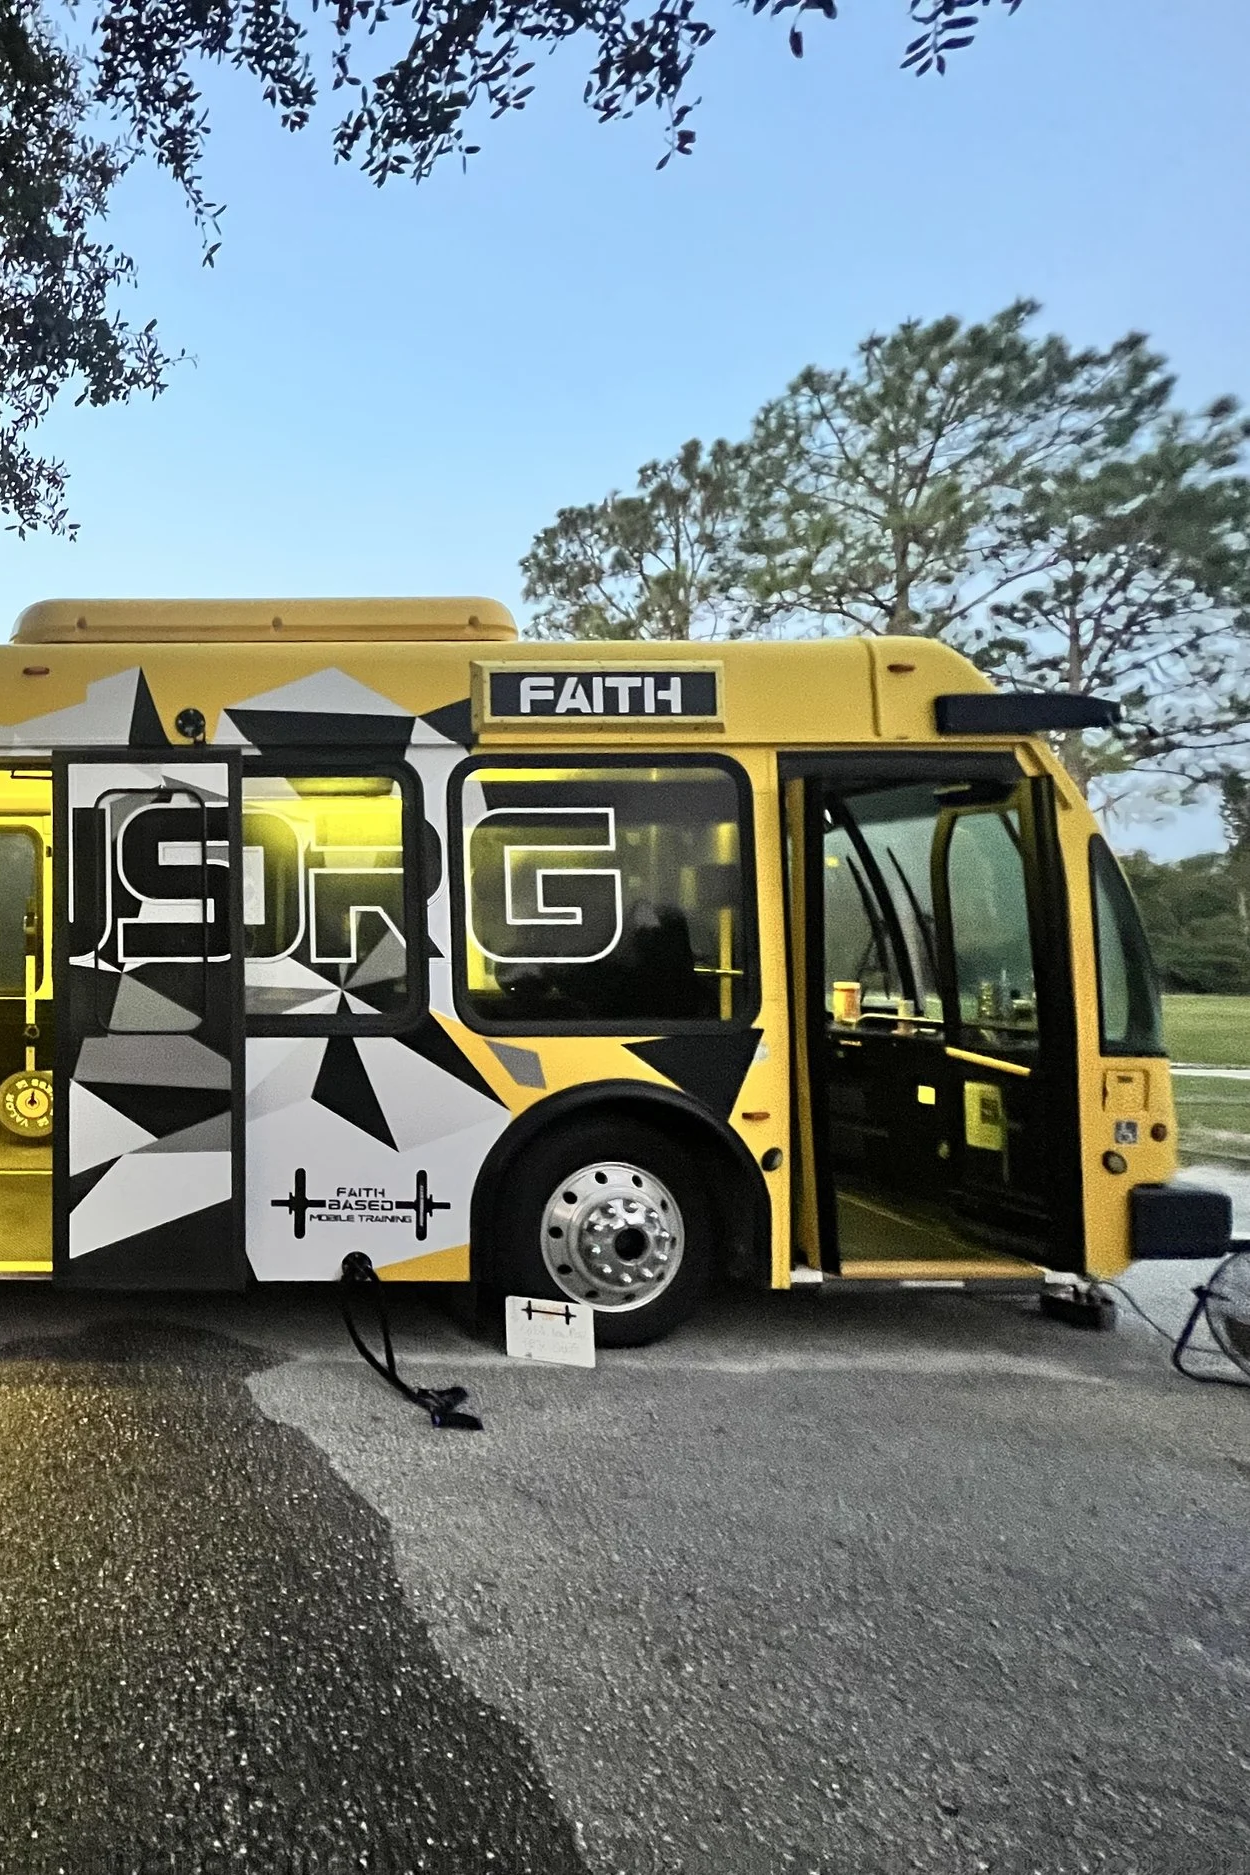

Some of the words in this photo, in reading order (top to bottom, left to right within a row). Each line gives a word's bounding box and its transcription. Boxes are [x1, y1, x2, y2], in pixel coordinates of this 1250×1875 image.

[519, 676, 682, 713] FAITH
[336, 1187, 385, 1198] FAITH
[328, 1199, 393, 1211] BASED
[310, 1214, 355, 1222] MOBILE
[358, 1214, 412, 1223] TRAINING
